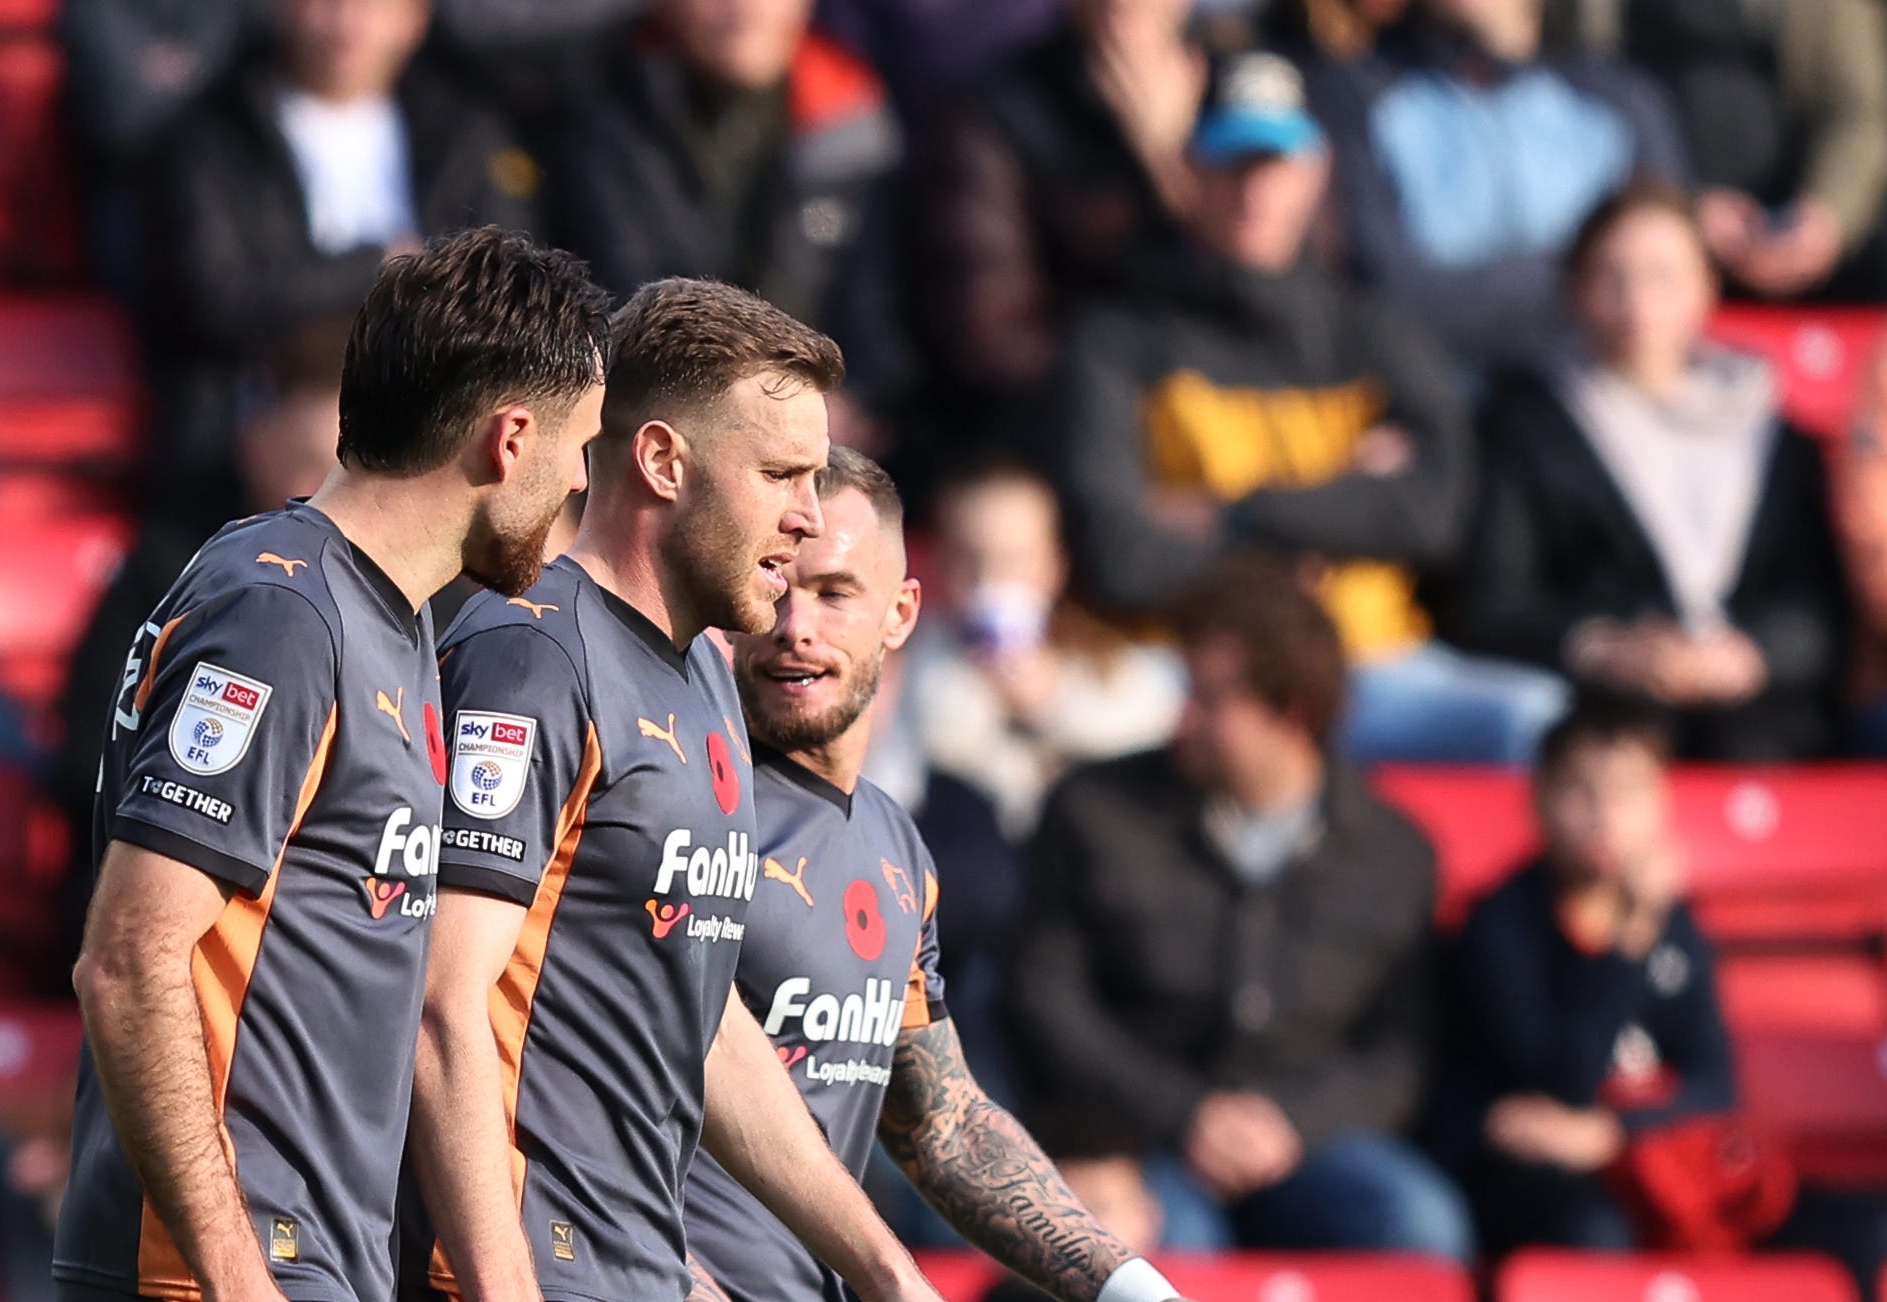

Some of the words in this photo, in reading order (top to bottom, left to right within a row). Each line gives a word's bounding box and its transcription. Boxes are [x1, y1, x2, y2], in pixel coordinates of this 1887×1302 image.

[195, 675, 223, 696] sky
[226, 687, 257, 707] bet
[189, 694, 252, 722] CHAMPIONSHIP
[460, 720, 489, 739] sky
[494, 723, 524, 742] bet
[186, 746, 211, 766] EFL
[458, 742, 526, 758] CHAMPIONSHIP
[470, 792, 497, 807] EFL
